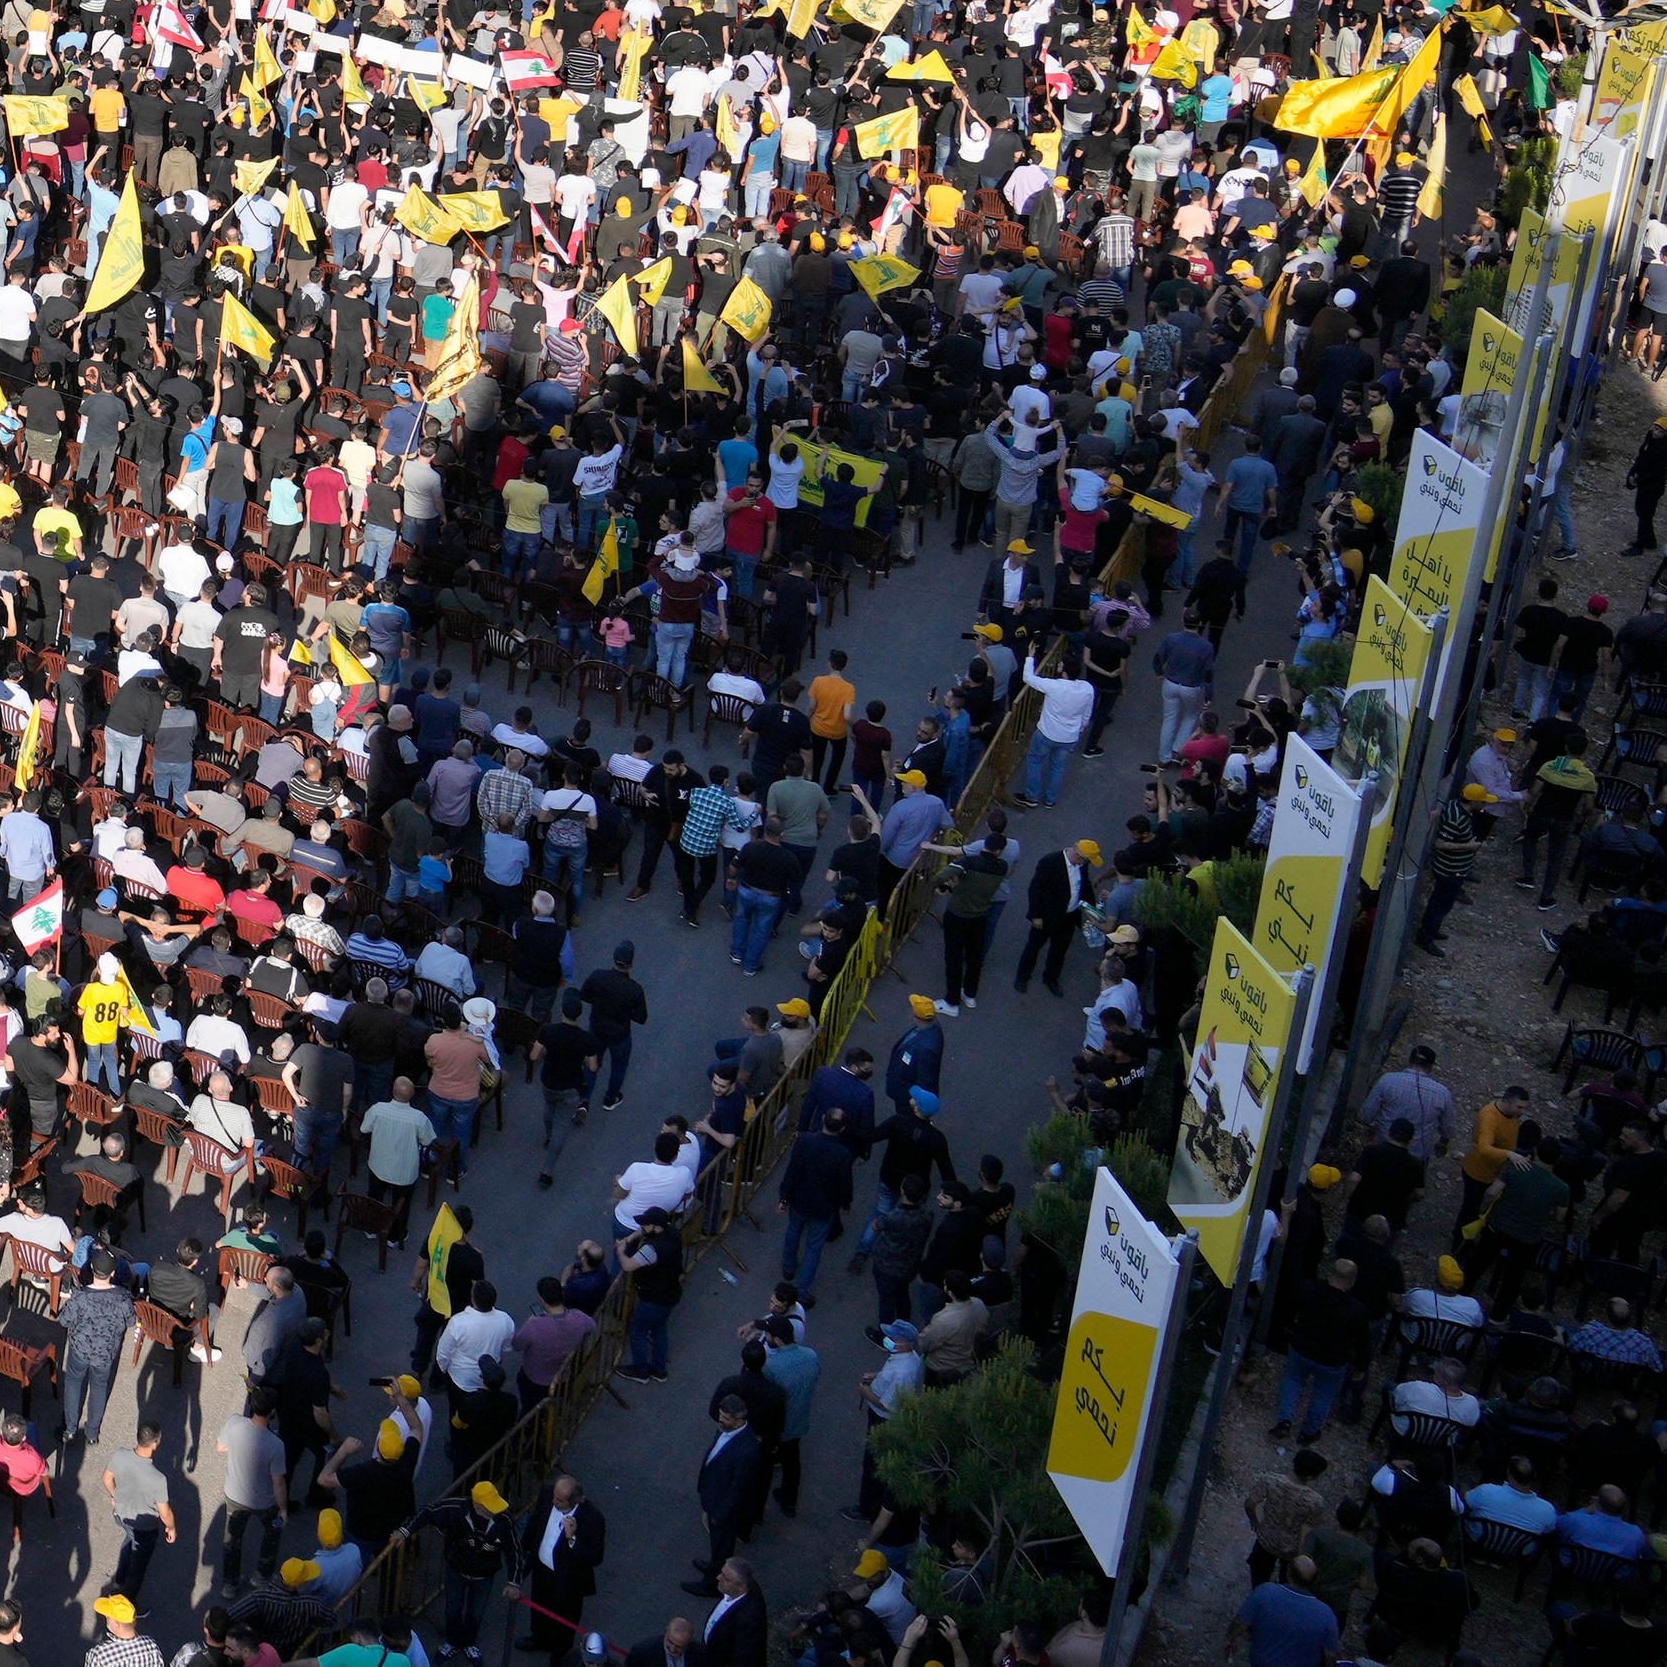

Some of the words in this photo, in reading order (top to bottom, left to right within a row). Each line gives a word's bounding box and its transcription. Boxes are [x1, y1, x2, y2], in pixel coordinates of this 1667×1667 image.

[1438, 470, 1465, 501] باقون
[1439, 496, 1462, 515] نحمي
[1406, 541, 1443, 576] أهل
[1403, 564, 1449, 609] البصيرة
[1443, 565, 1452, 588] يا
[1386, 621, 1407, 654] باقون
[1291, 794, 1310, 820] ونبني
[1308, 784, 1334, 823] باقون
[1309, 816, 1332, 839] نحمي
[1275, 879, 1314, 934] بكم
[1269, 917, 1309, 966] نبني
[95, 1001, 119, 1023] 88
[1221, 985, 1241, 1014] ونبني
[1240, 975, 1267, 1018] باقون
[1239, 1010, 1264, 1036] نحمي
[1100, 1241, 1121, 1275] ونبني
[1120, 1233, 1149, 1284] باقون
[1119, 1272, 1145, 1303] نحمي
[1082, 1337, 1125, 1413] بكم
[1076, 1387, 1117, 1447] نحمي
